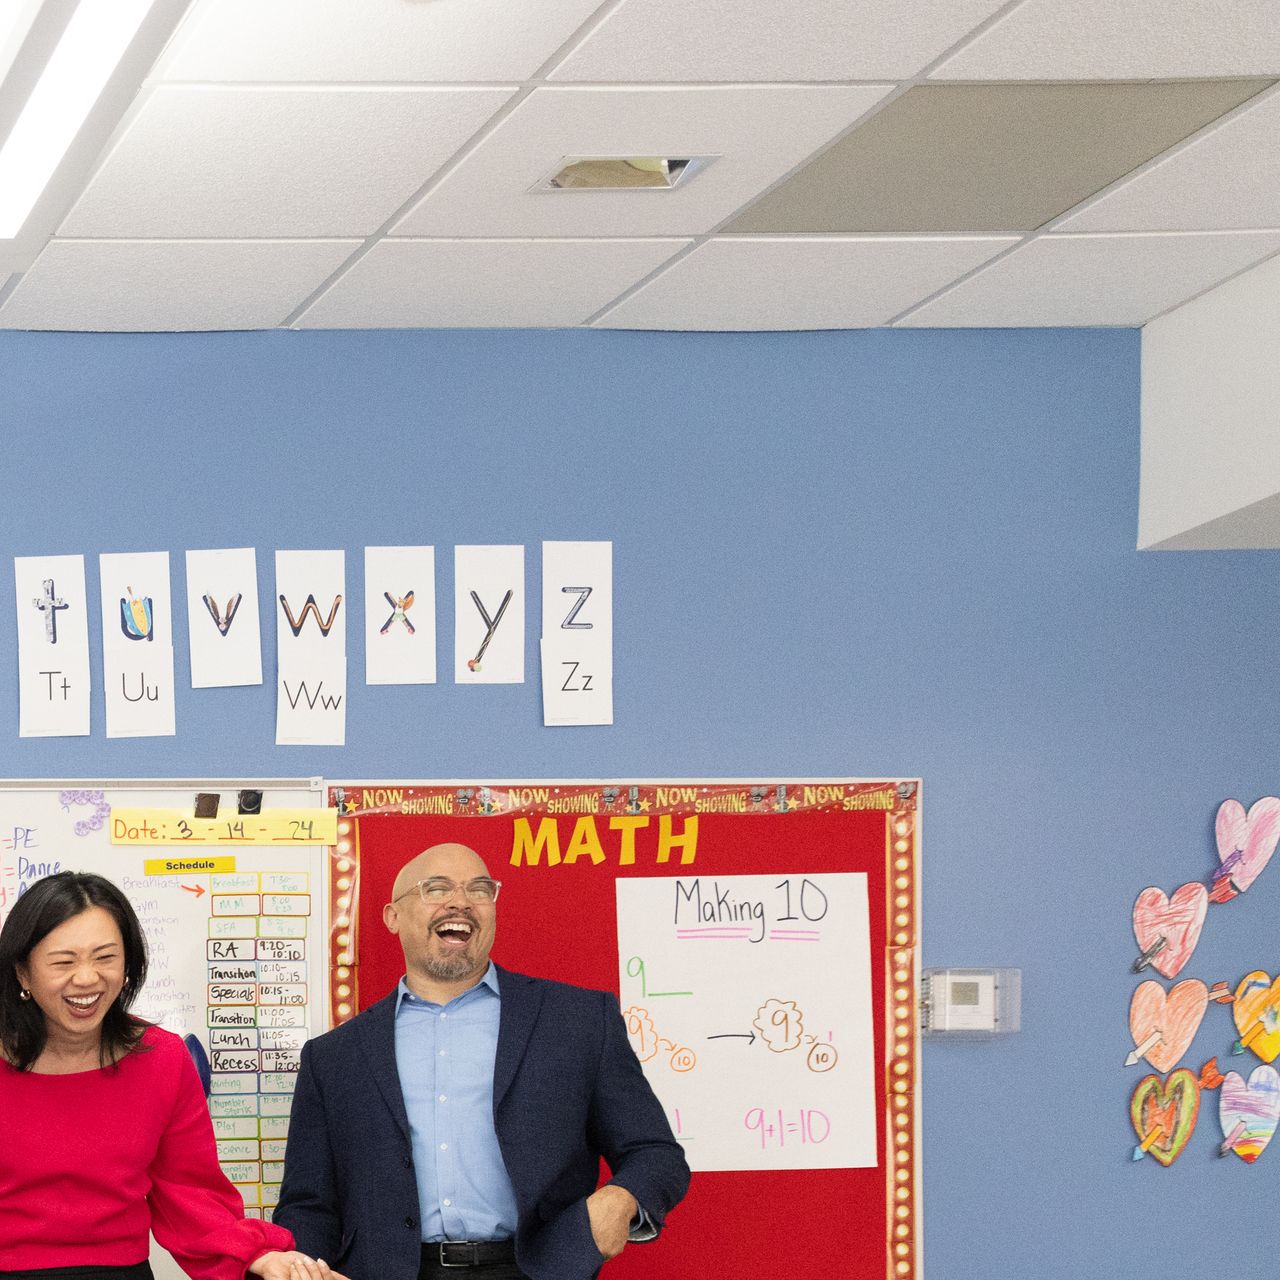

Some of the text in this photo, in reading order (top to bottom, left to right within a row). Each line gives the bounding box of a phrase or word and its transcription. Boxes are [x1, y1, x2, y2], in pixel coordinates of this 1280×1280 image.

[211, 590, 243, 638] v
[279, 593, 343, 639] w
[381, 590, 416, 636] x
[466, 586, 514, 674] y
[39, 671, 71, 701] Tt
[122, 672, 159, 702] Uu
[561, 661, 593, 692] Zz
[283, 680, 342, 710] Ww
[362, 789, 454, 815] NOW SHOWING
[13, 827, 40, 850] PE
[114, 818, 314, 840] Date: 3 14 24
[509, 815, 699, 867] MATH
[166, 861, 215, 871] Schedule
[674, 879, 828, 944] Making 10
[213, 942, 239, 958] RA
[272, 951, 301, 960] 10:10
[211, 986, 254, 1001] Specials
[280, 995, 304, 1005] 11:00
[210, 1010, 255, 1024] Transition
[211, 1031, 250, 1047] Lunch
[214, 1052, 258, 1071] Recess
